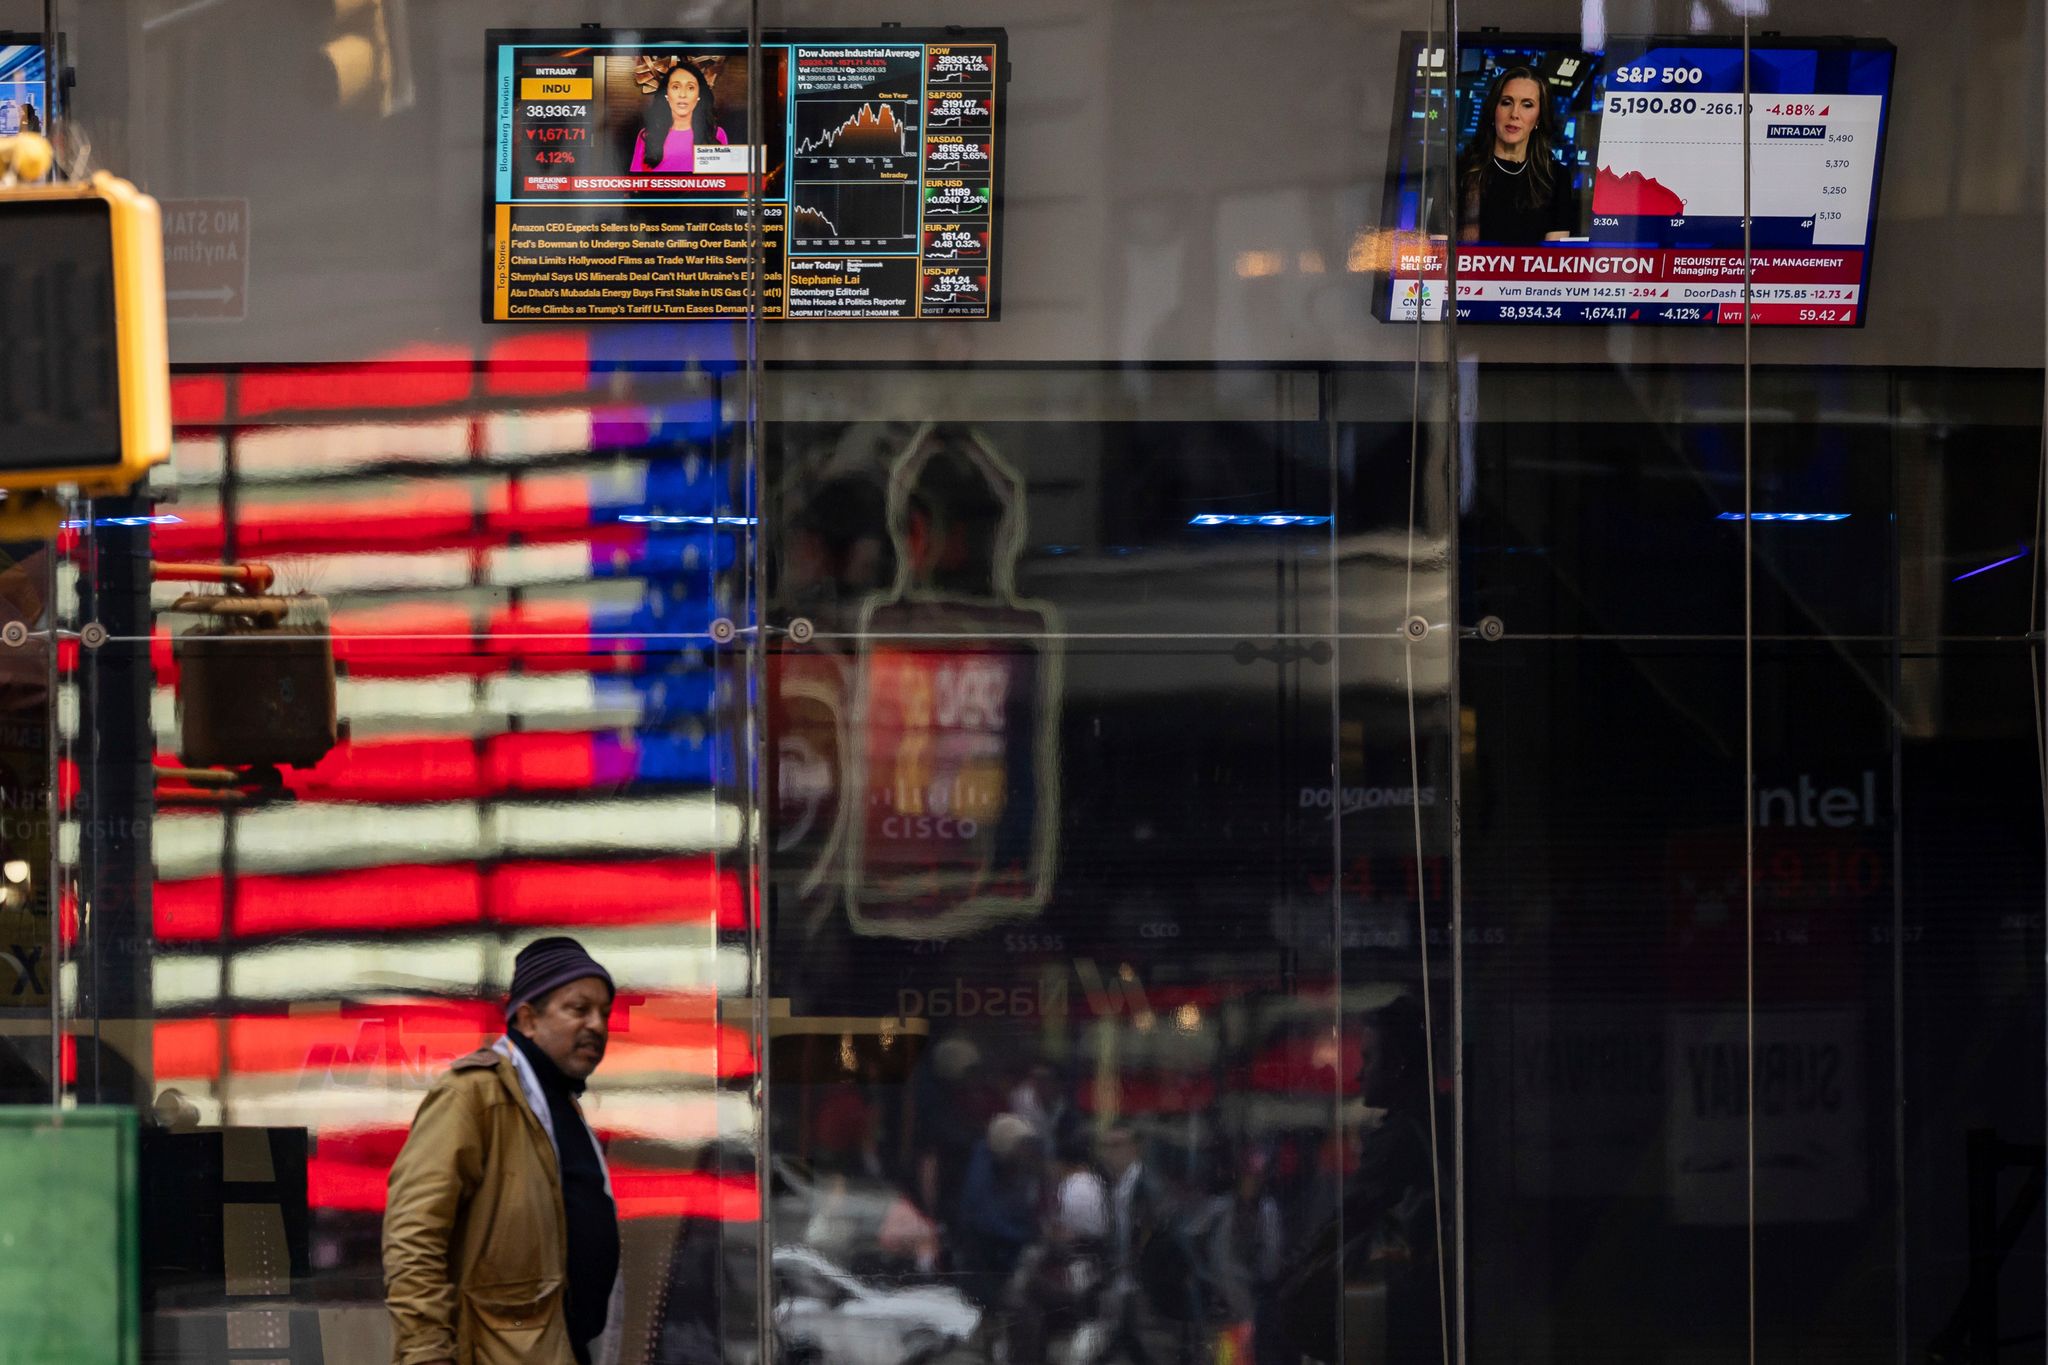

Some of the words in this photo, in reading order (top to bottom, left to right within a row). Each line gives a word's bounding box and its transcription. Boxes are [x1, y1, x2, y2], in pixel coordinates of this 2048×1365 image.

[799, 49, 818, 57] Dow
[819, 49, 844, 57] Jones
[845, 49, 884, 57] Industrial
[885, 49, 920, 59] Average
[1616, 67, 1656, 83] S&P
[1661, 68, 1702, 84] 500
[542, 84, 571, 94] INDU
[527, 106, 586, 118] 38,936.74
[1609, 98, 1697, 117] 5,190.80
[1766, 105, 1815, 116] -4.88%
[538, 129, 585, 141] 1,671.71
[1770, 127, 1800, 136] INTRA
[1802, 128, 1823, 136] DAY
[1828, 134, 1854, 144] 5,490
[500, 121, 510, 172] Bloomberg
[938, 144, 978, 152] 16156.62
[535, 152, 574, 163] 4.12%
[1825, 160, 1850, 170] 5,370
[574, 179, 589, 188] US
[590, 179, 630, 188] STOCKS
[633, 179, 648, 188] HIT
[651, 179, 695, 188] SESSION
[697, 179, 726, 188] LOWS
[1822, 186, 1847, 196] 5,250
[1819, 212, 1842, 221] 5,130
[1594, 218, 1618, 226] 9:30A
[1670, 219, 1684, 227] 12P
[1801, 220, 1812, 228] 4P
[512, 224, 544, 232] Amazon
[546, 224, 565, 232] CEO
[566, 224, 599, 233] Expects
[601, 224, 628, 232] Sellers
[630, 224, 638, 232] to
[512, 240, 536, 248] Fed's
[538, 240, 578, 248] Bowman
[580, 240, 589, 248] to
[591, 240, 630, 249] Undergo
[632, 240, 664, 248] Senate
[667, 240, 698, 249] Grilling
[700, 240, 721, 248] Over
[724, 240, 747, 248] Bank
[511, 256, 537, 264] China
[539, 256, 566, 264] Limits
[568, 256, 616, 266] Hollywood
[618, 256, 642, 264] Films
[657, 256, 683, 264] Trade
[685, 256, 704, 264] War
[706, 256, 723, 264] Hits
[815, 262, 840, 270] Today
[1458, 255, 1515, 272] BRYN
[1521, 256, 1654, 274] TALKINGTON
[1674, 257, 1726, 266] REQUISITE
[1772, 259, 1843, 267] MANAGEMENT
[1673, 267, 1718, 276] Managing
[497, 274, 507, 290] Top
[511, 273, 549, 282] Shmyhal
[551, 273, 573, 282] Says
[575, 273, 588, 281] US
[590, 273, 627, 281] Minerals
[630, 273, 649, 281] Deal
[791, 276, 842, 286] Stephanie
[845, 275, 860, 284] Lai
[511, 289, 527, 297] Abu
[529, 289, 559, 297] Dhabi's
[561, 289, 601, 297] Mubadala
[602, 289, 631, 298] Energy
[633, 289, 653, 298] Buys
[791, 288, 834, 297] Bloomberg
[1499, 287, 1523, 296] Yum
[1526, 287, 1562, 296] Brands
[1565, 288, 1589, 296] YUM
[1593, 288, 1625, 297] 142.51
[1629, 289, 1656, 297] -2.94
[1684, 289, 1737, 298] DoorDash
[1774, 290, 1807, 298] 175.85
[1810, 290, 1840, 299] -12.73
[510, 305, 541, 313] Coffee
[543, 305, 573, 313] Climbs
[588, 305, 625, 314] Trump's
[628, 305, 651, 313] Tariff
[653, 305, 685, 313] U-Turn
[687, 305, 714, 313] Eases
[1500, 307, 1562, 319] 38,934.34
[1580, 308, 1626, 319] -1,674.11
[1659, 309, 1700, 320] -4.12%
[1724, 312, 1742, 320] WTI
[1799, 310, 1835, 321] 59.42
